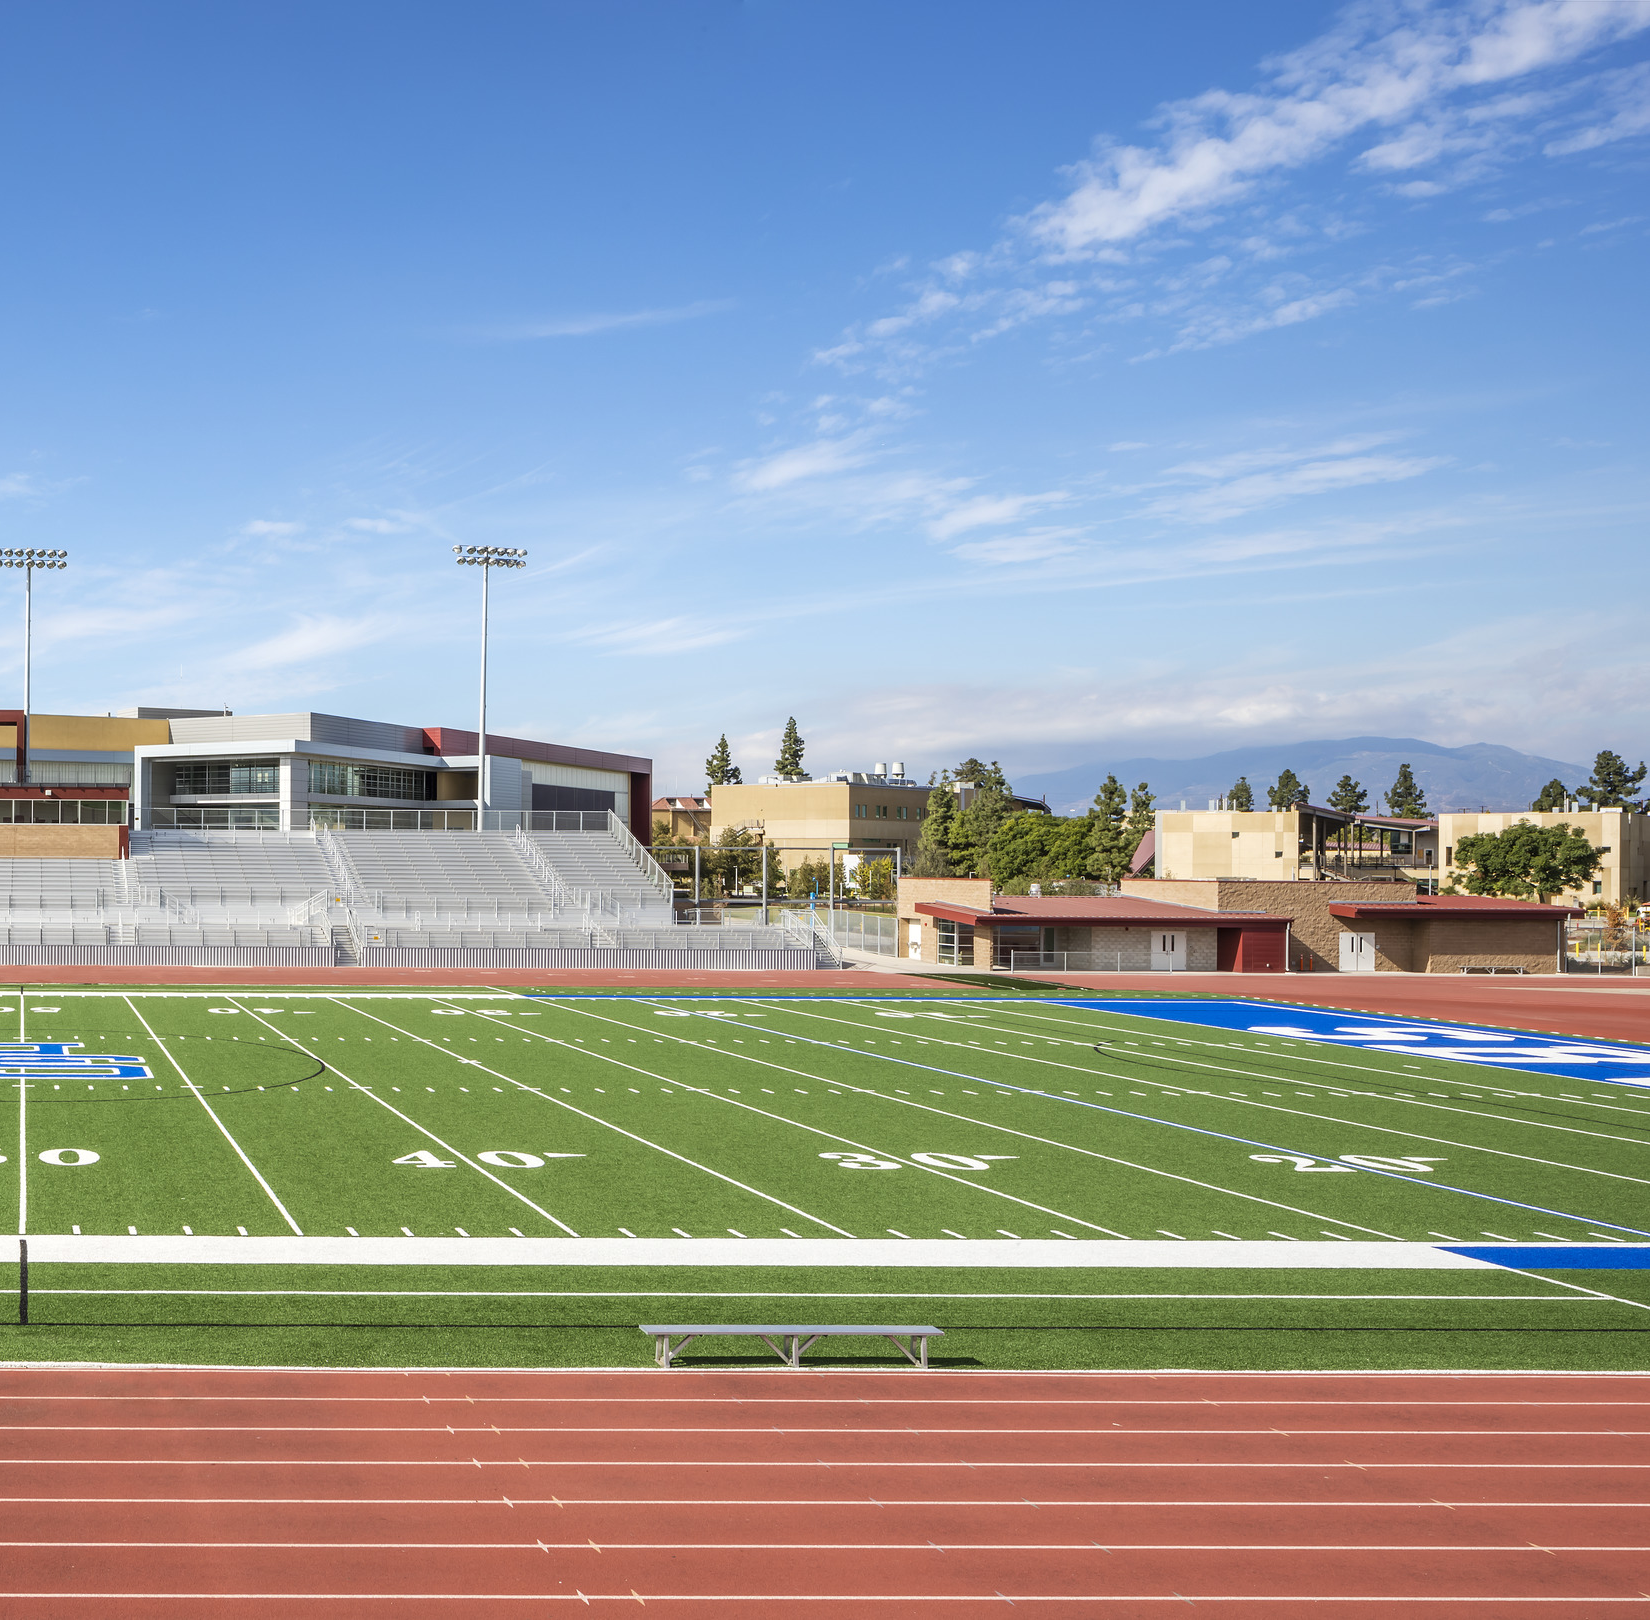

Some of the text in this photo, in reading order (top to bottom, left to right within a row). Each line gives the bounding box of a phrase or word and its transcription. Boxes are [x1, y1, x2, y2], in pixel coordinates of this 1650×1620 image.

[392, 1150, 545, 1168] 40
[818, 1152, 990, 1171] 30
[1249, 1154, 1435, 1173] 20
